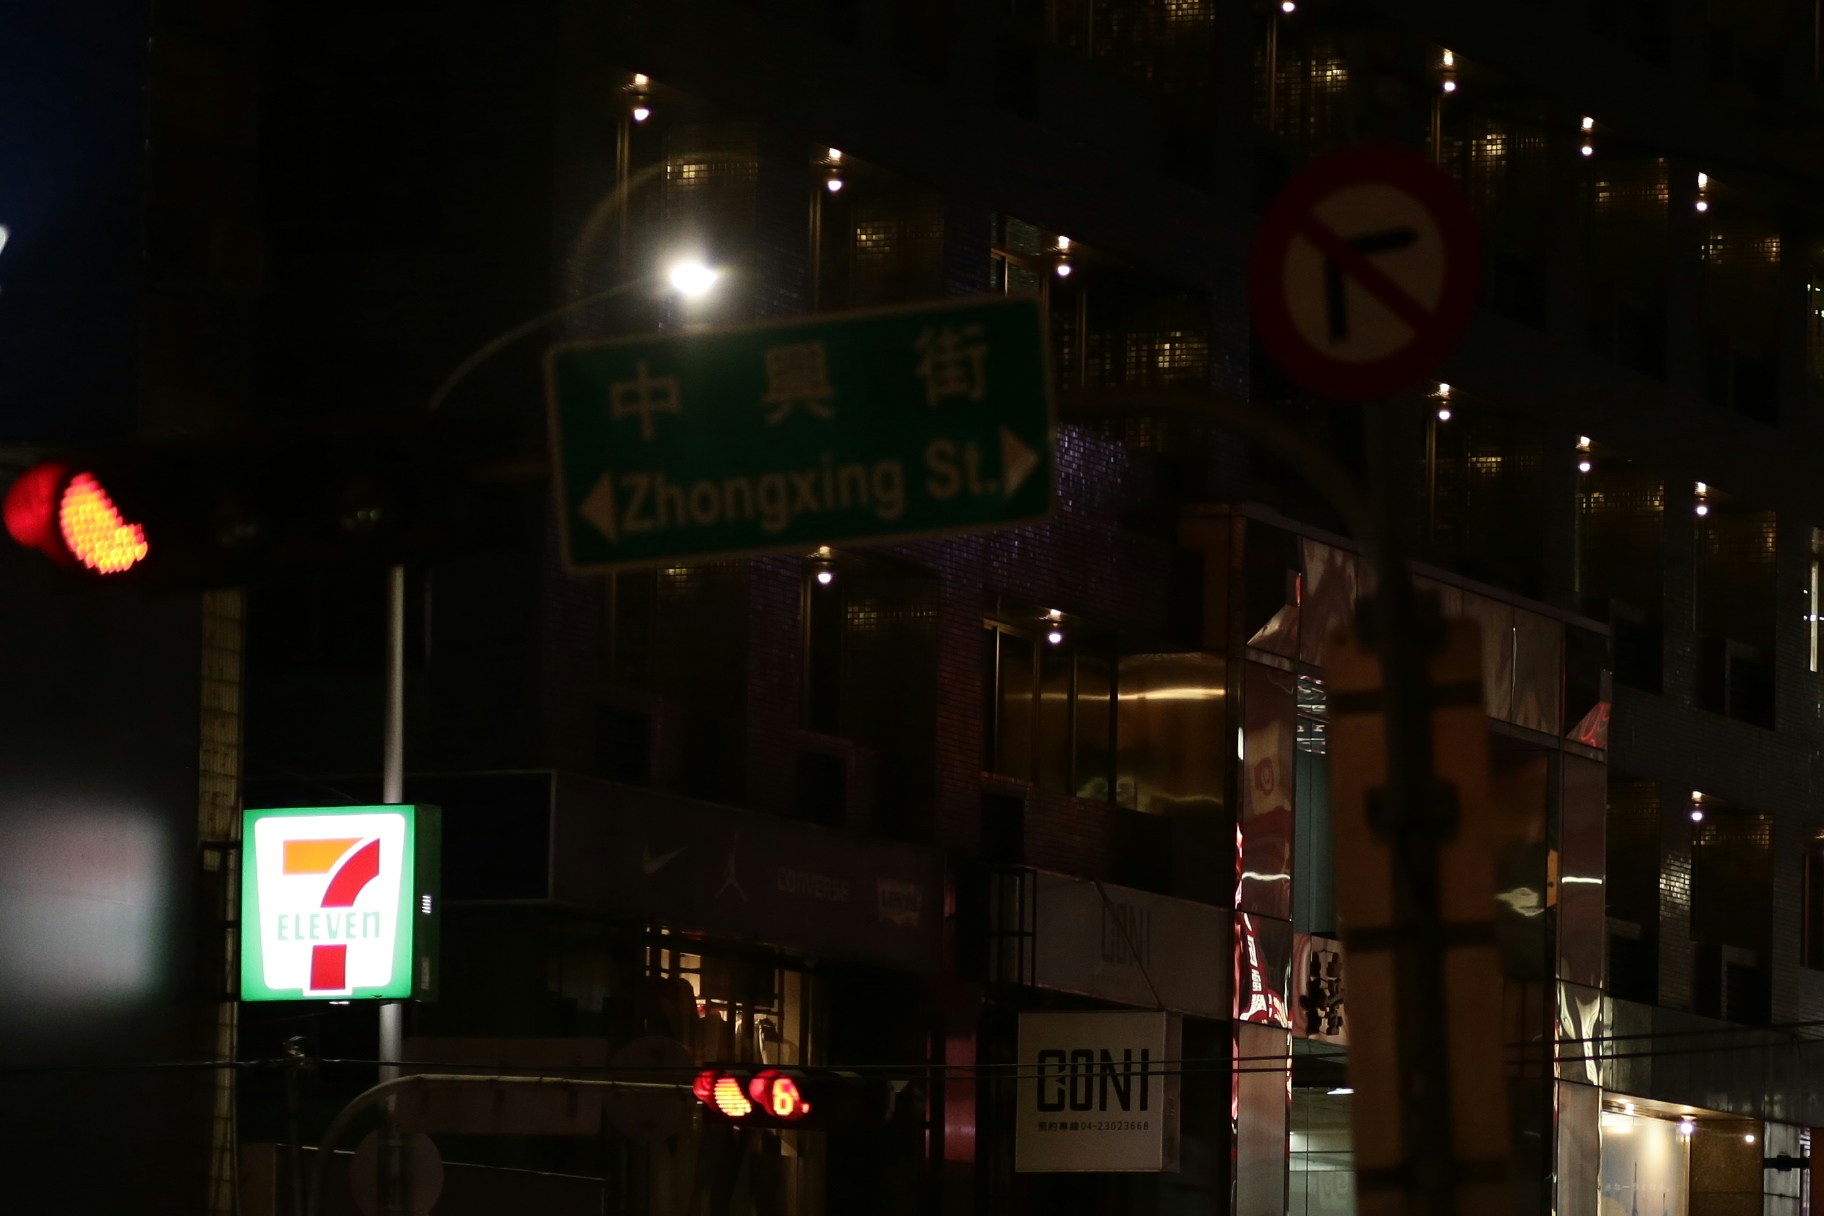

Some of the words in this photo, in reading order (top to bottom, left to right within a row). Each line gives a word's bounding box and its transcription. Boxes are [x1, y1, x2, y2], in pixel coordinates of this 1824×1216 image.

[609, 324, 991, 442] 中興街
[619, 451, 908, 536] Zhongxing
[923, 437, 1000, 503] St.
[283, 837, 381, 991] 7
[1036, 1048, 1149, 1113] CONI
